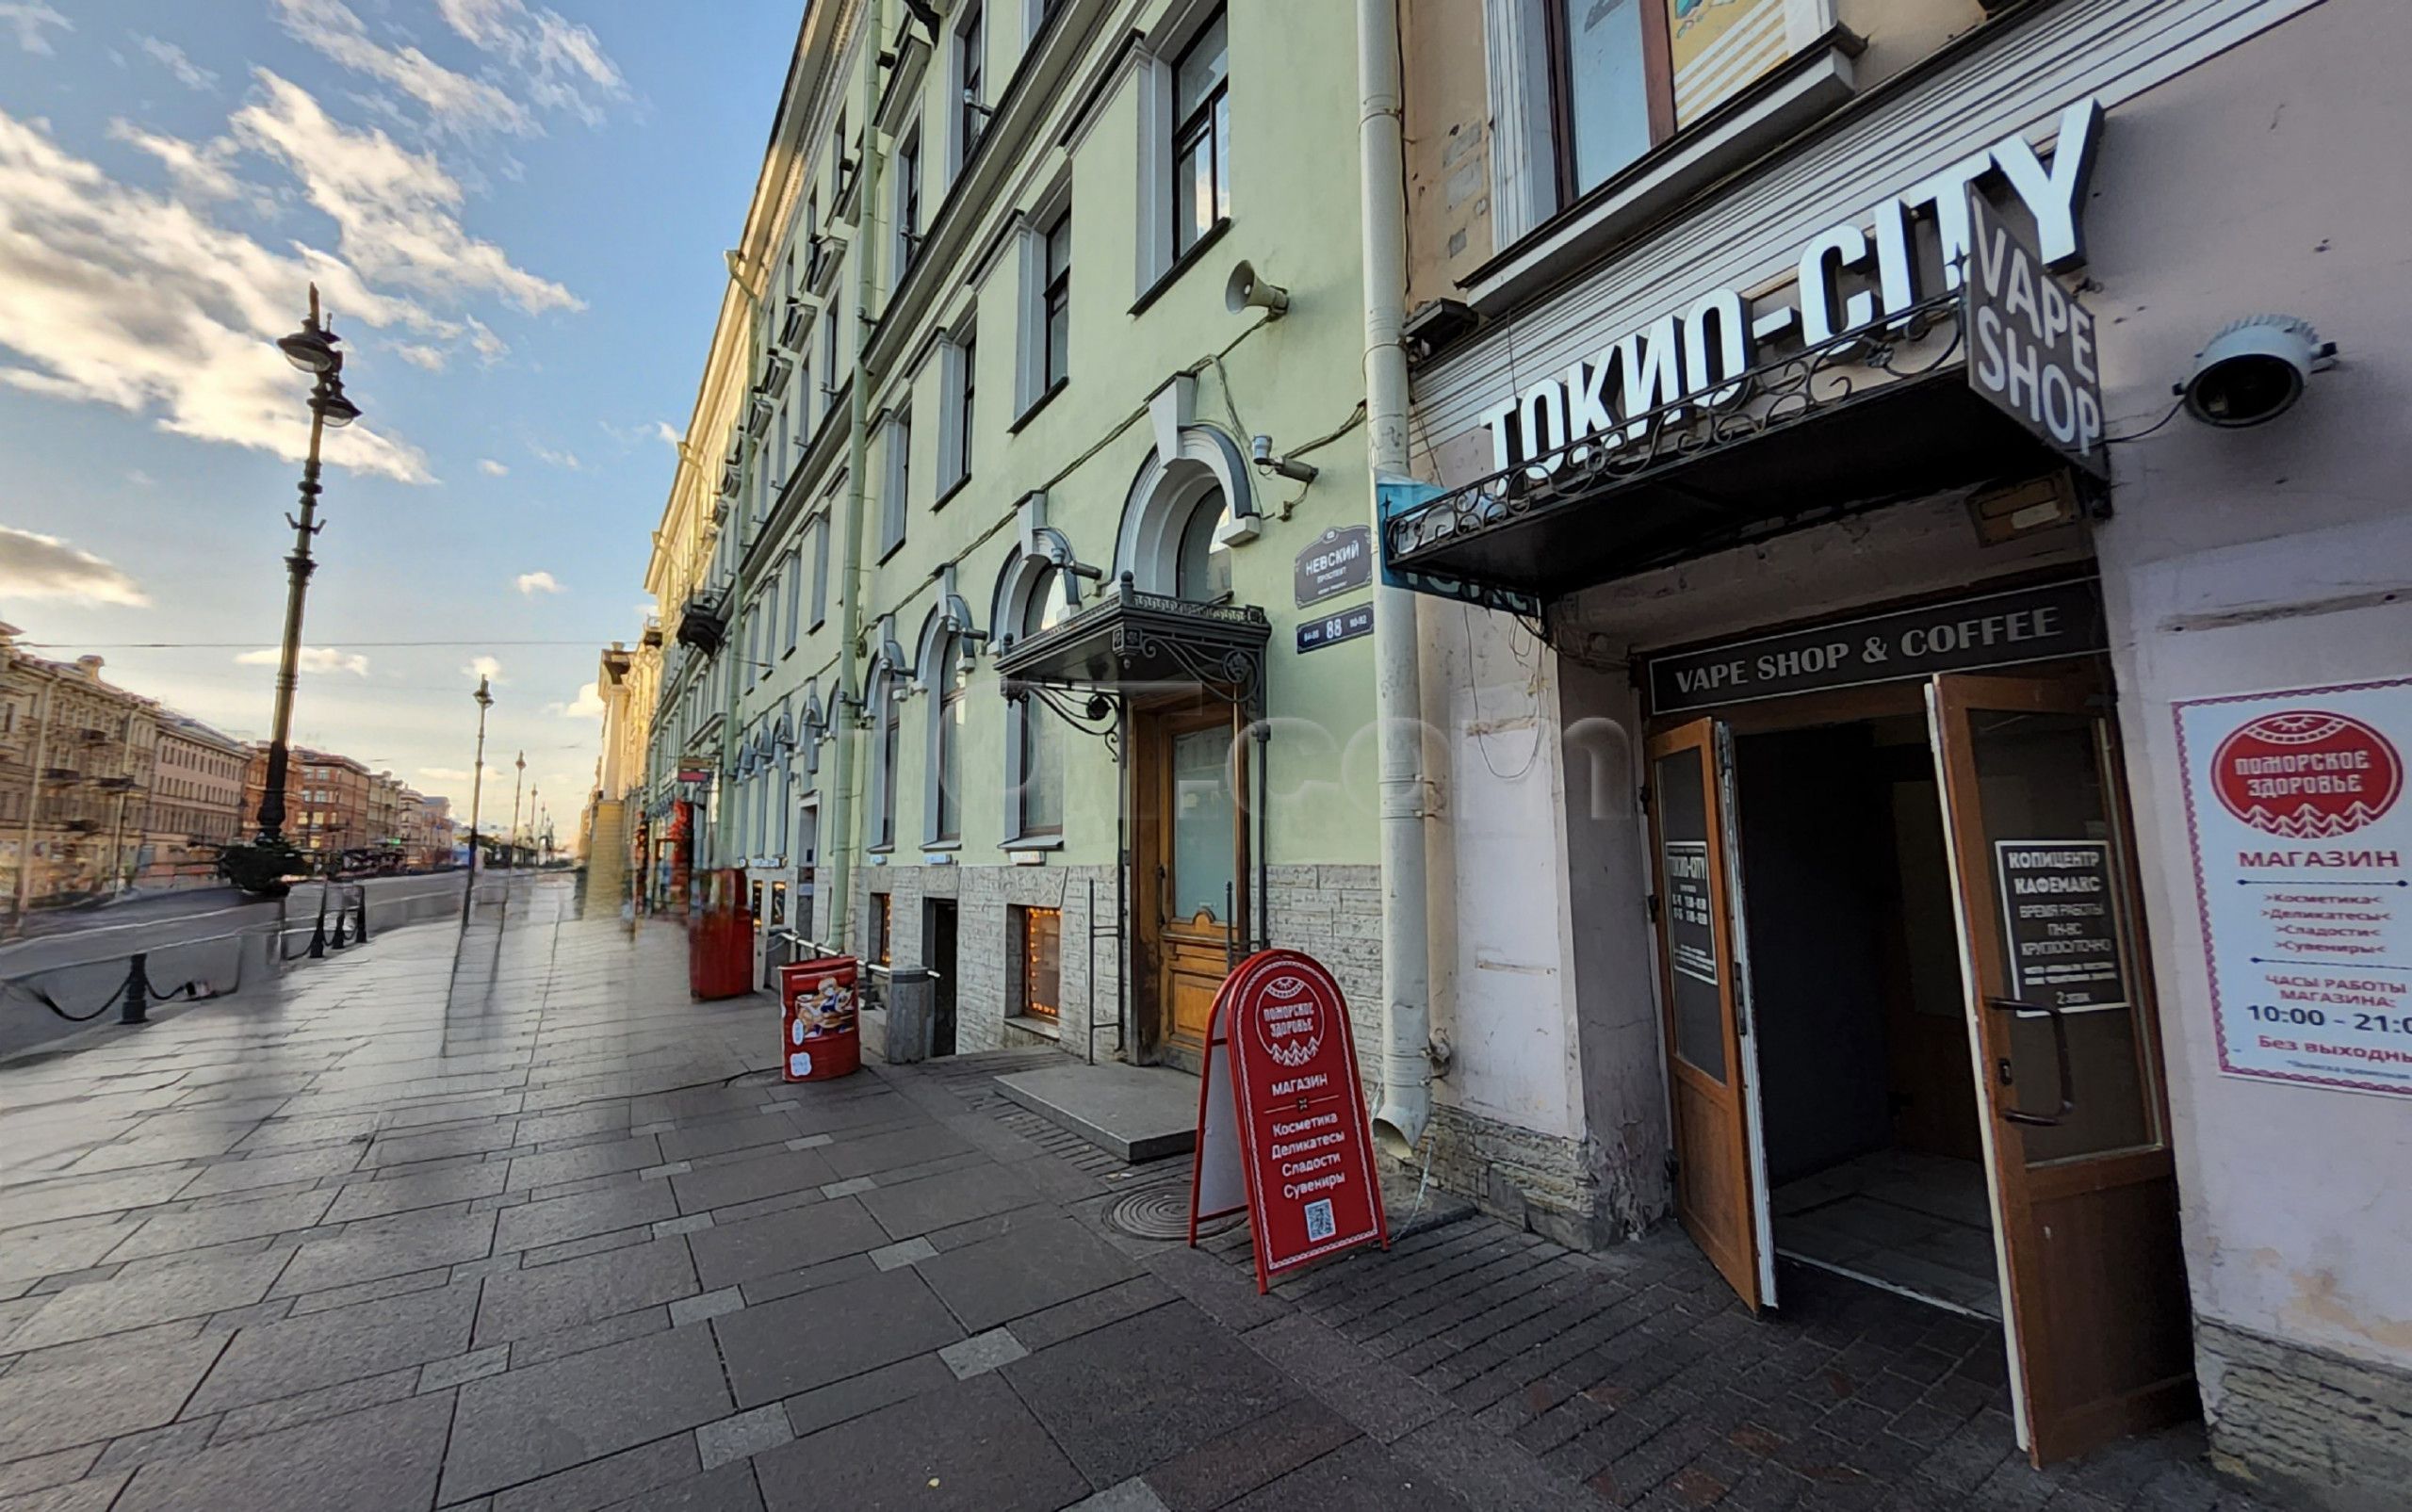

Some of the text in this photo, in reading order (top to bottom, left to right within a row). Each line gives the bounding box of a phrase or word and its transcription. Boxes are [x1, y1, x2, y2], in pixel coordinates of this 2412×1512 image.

[1973, 195, 2095, 383] VAPE
[1979, 305, 2099, 456] SHOP
[1305, 540, 1360, 576] НЕВСКИЙ
[1326, 618, 1343, 639] 88
[1676, 607, 2063, 693] VAPE SHOP & COFFEE
[2234, 751, 2371, 775] ПОМОРСКОЕ
[2247, 774, 2363, 798] ЗДОРОВЬЕ
[2008, 852, 2100, 869] КОПИЦЕНТР
[2239, 851, 2399, 867] МАГАЗИН
[2013, 876, 2102, 894] КАФЕМАКС
[2265, 974, 2407, 994] ЧАСЫ РАБОТЫ
[2056, 991, 2066, 1004] 2
[2280, 990, 2397, 1008] МАГАЗИНА:
[2247, 1005, 2325, 1026] 10:00
[2258, 1035, 2298, 1050] Без
[1272, 1073, 1328, 1097] МАГАЗИН
[1272, 1113, 1338, 1137] Косметика
[1272, 1130, 1345, 1160] Деликатесы
[1282, 1153, 1341, 1177] Сладости
[1283, 1172, 1345, 1200] Сувениры
